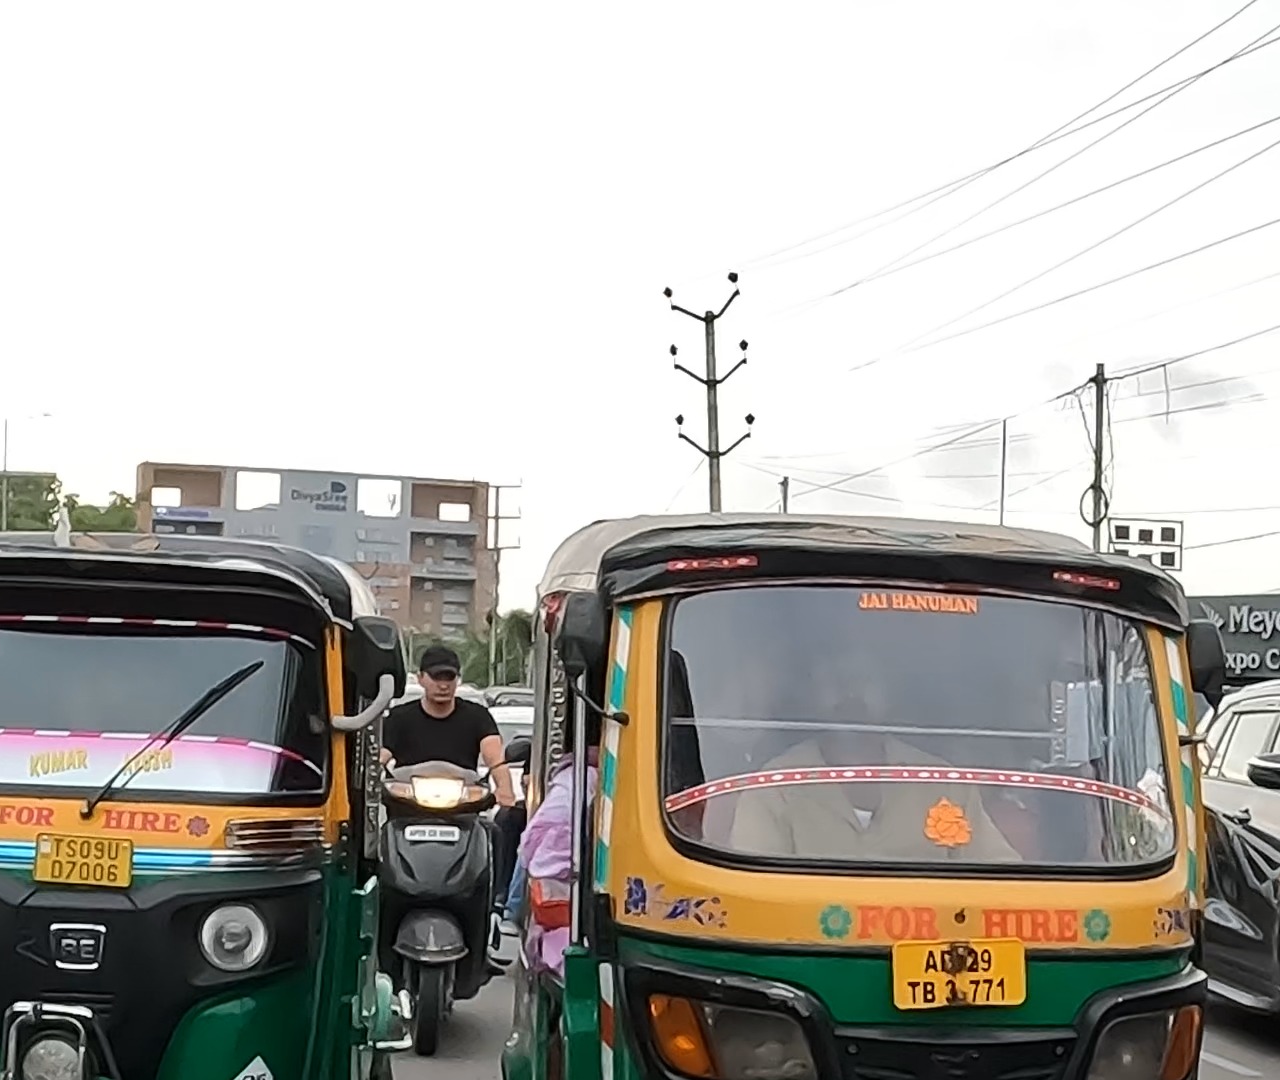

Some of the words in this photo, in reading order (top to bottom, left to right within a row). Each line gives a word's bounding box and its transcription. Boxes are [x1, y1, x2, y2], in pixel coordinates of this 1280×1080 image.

[859, 592, 889, 609] JAI
[892, 593, 978, 614] HANUMAN
[1224, 651, 1261, 675] xpo
[28, 749, 89, 778] KUMAR
[102, 808, 182, 833] HIRE
[53, 838, 119, 860] TS09U
[51, 860, 118, 882] D7006
[855, 905, 941, 940] FOR
[981, 908, 1079, 943] HIRE
[907, 981, 936, 1004] TB
